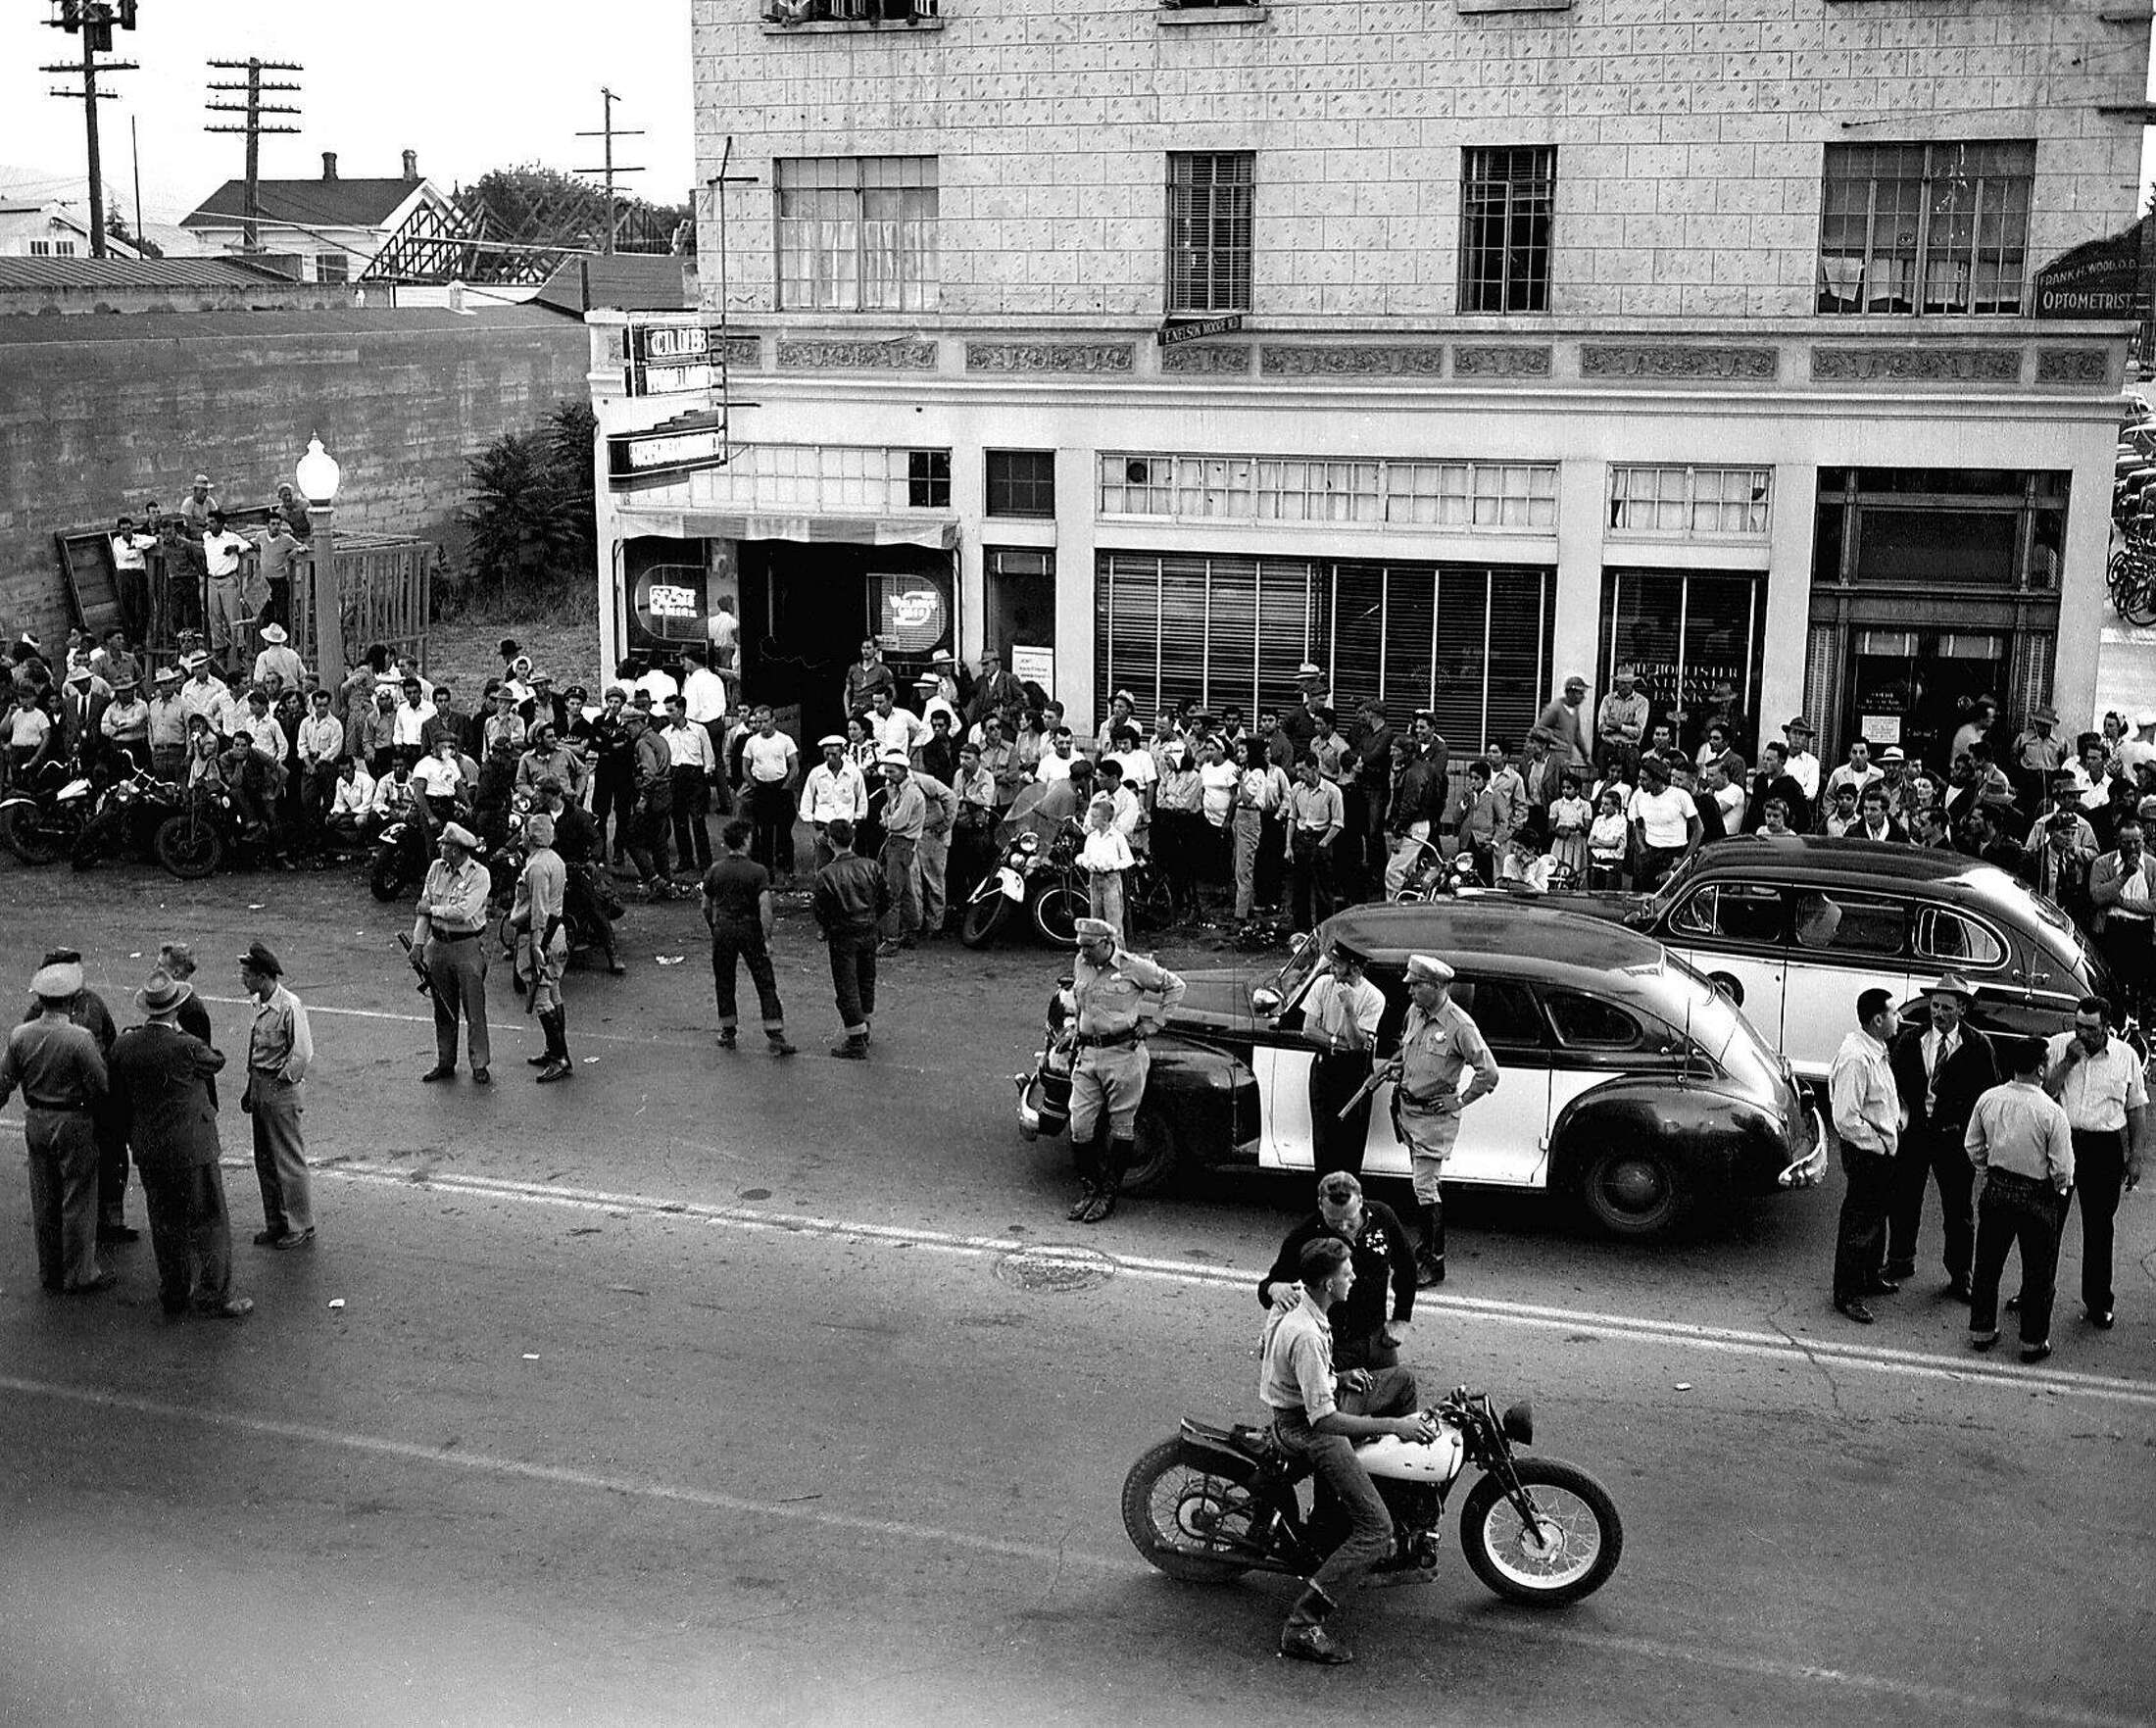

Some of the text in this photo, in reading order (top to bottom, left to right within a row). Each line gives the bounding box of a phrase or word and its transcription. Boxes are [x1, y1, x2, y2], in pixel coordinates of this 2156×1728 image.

[2039, 270, 2075, 286] FRANK
[2042, 290, 2133, 311] OPTOMETRIST
[651, 328, 707, 356] CLUB
